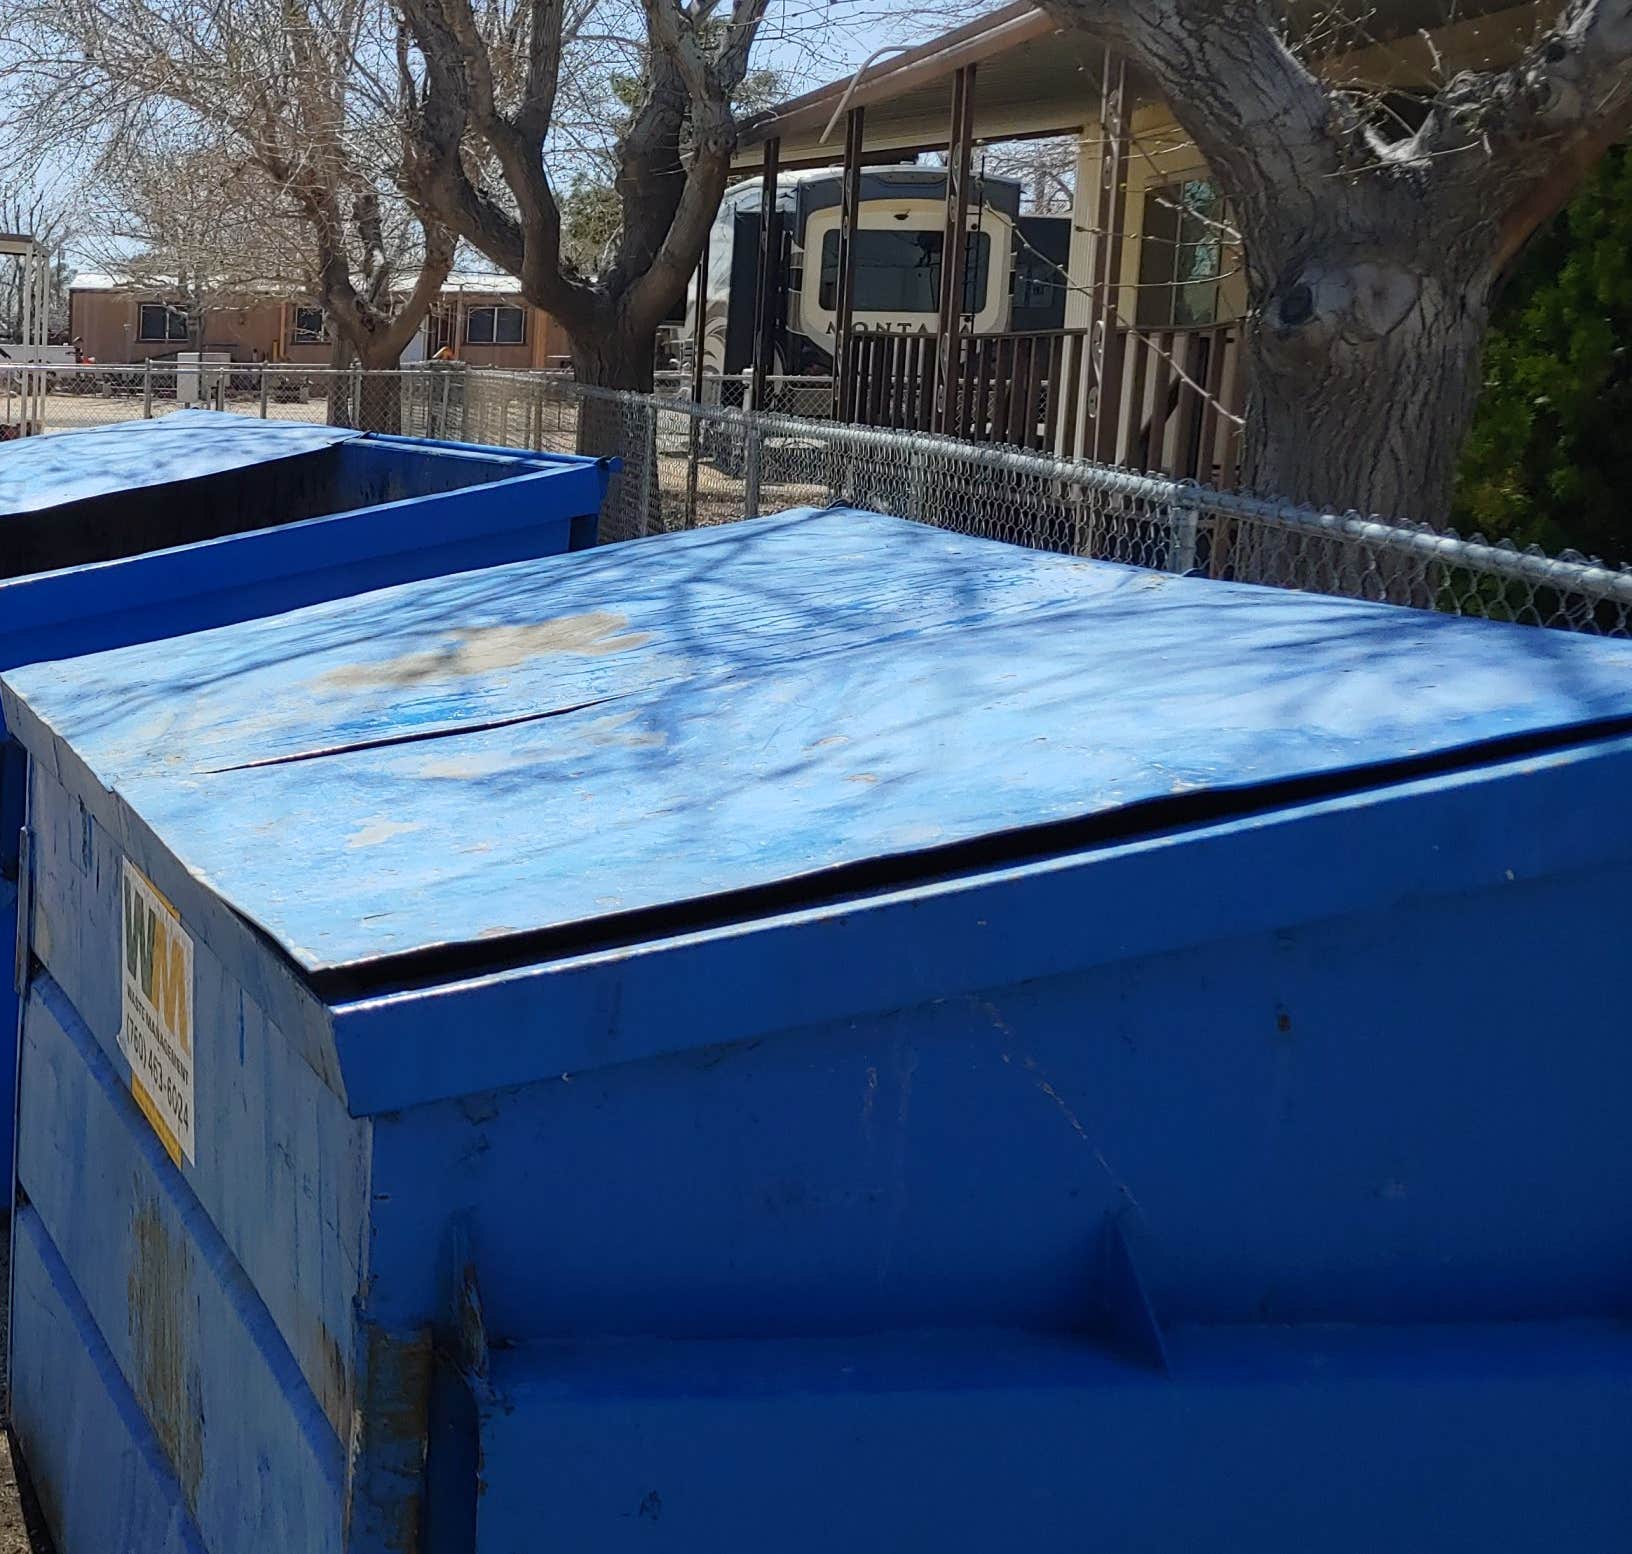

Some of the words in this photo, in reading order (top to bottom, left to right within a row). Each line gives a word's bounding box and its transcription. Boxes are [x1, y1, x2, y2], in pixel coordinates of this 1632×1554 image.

[825, 321, 971, 334] MONTAA
[123, 874, 191, 1058] WM
[125, 982, 145, 1022] WASTE
[145, 1015, 189, 1087] MANAGEMENT
[125, 1011, 146, 1069] (760)
[147, 1049, 190, 1133] 463-6024
